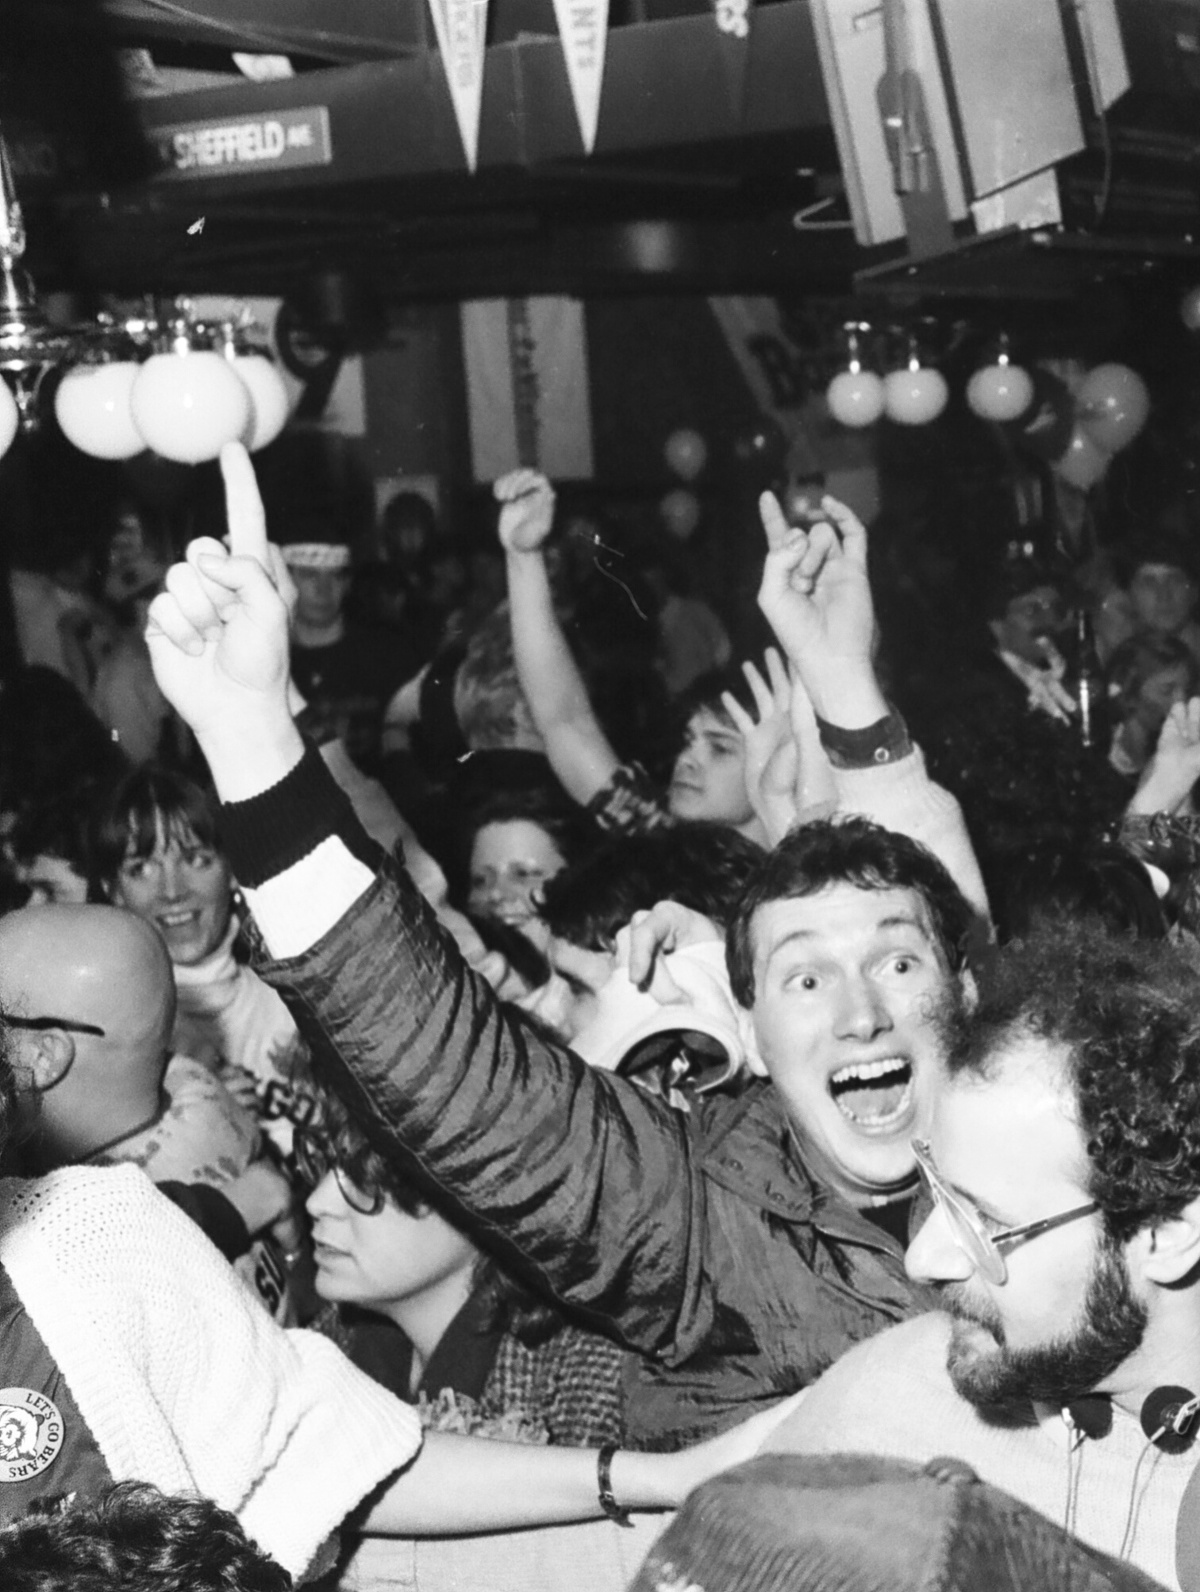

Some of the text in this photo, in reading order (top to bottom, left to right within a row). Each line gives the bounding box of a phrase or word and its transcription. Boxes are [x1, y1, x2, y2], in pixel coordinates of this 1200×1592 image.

[173, 121, 285, 169] SHEFFIELD
[8, 1393, 60, 1478] LET'S GO BEARS
